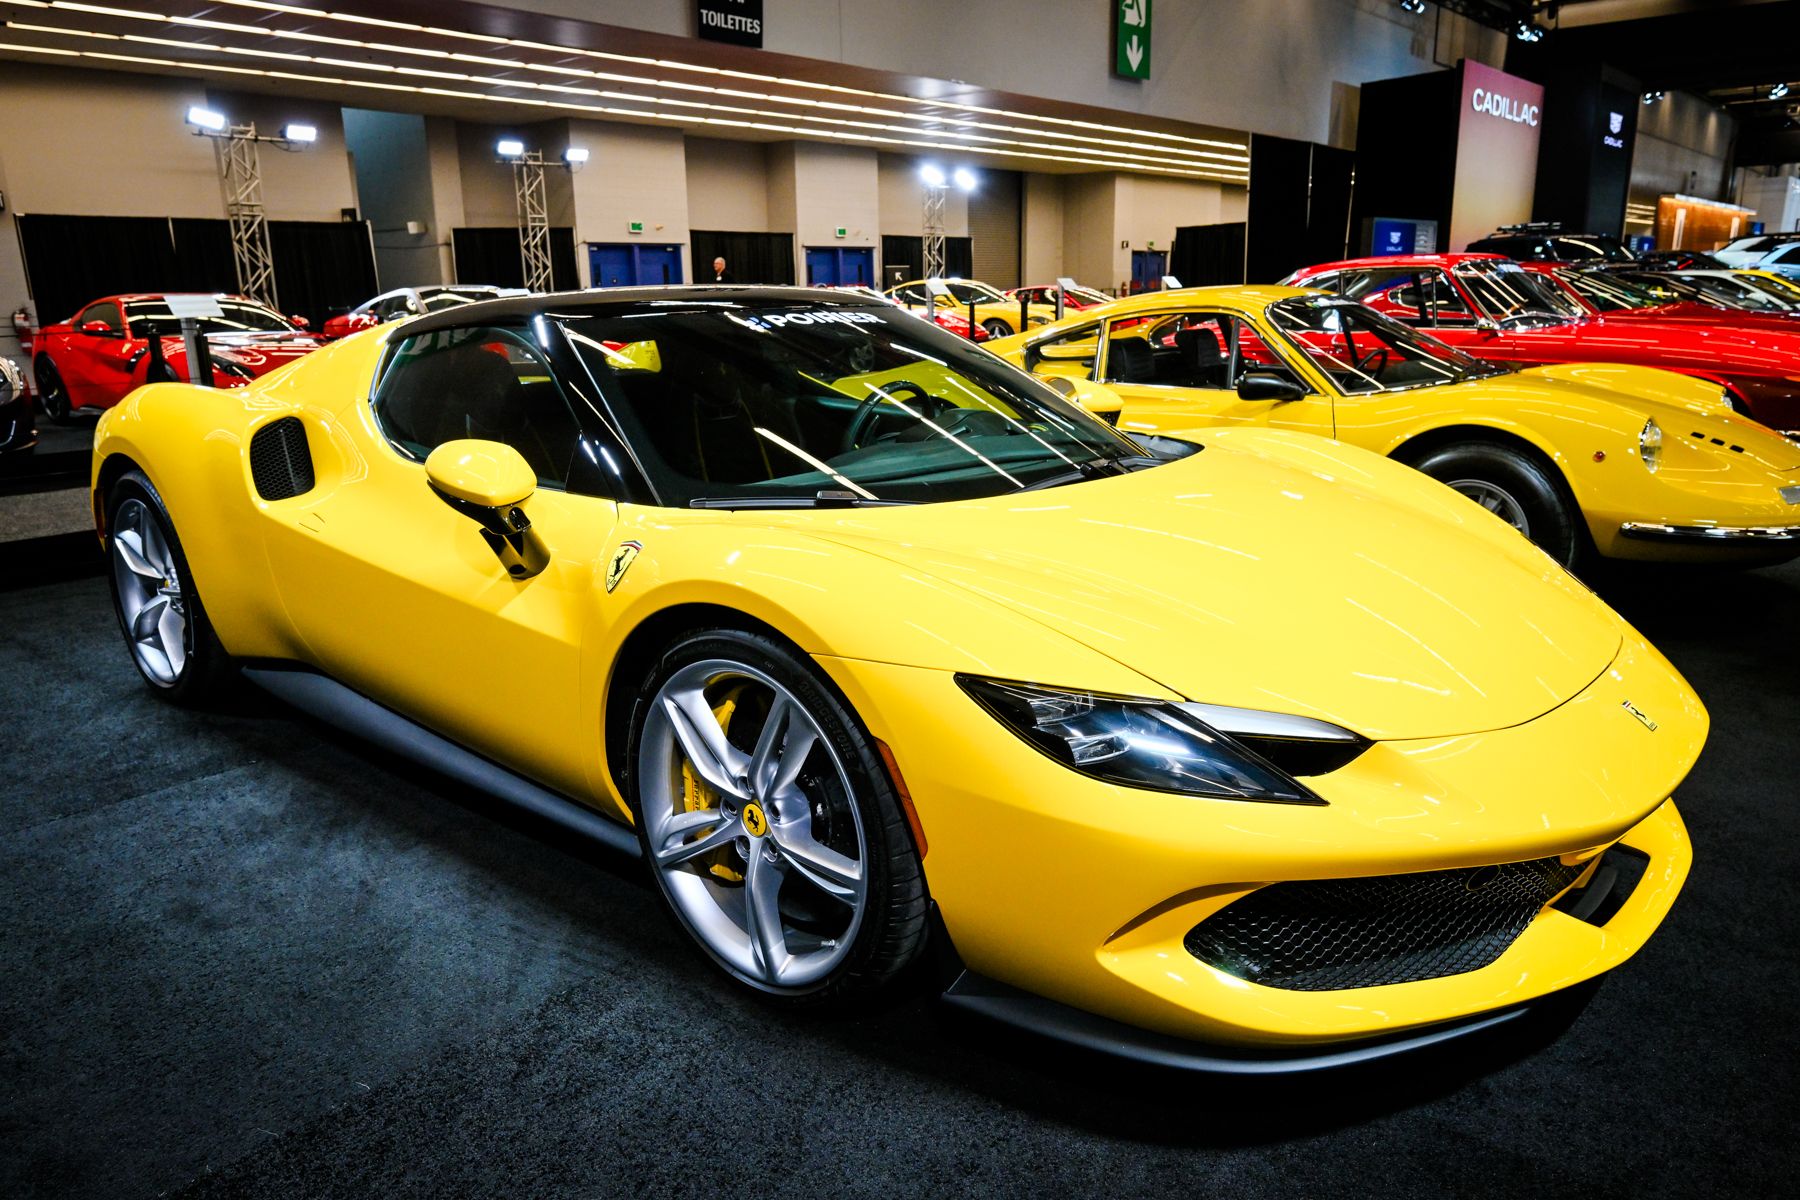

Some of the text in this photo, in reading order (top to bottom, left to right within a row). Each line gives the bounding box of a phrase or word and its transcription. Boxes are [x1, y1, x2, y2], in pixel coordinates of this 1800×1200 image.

[700, 9, 760, 34] TOILETTES
[1473, 88, 1539, 126] CADILLAC
[762, 311, 888, 327] POIRIER
